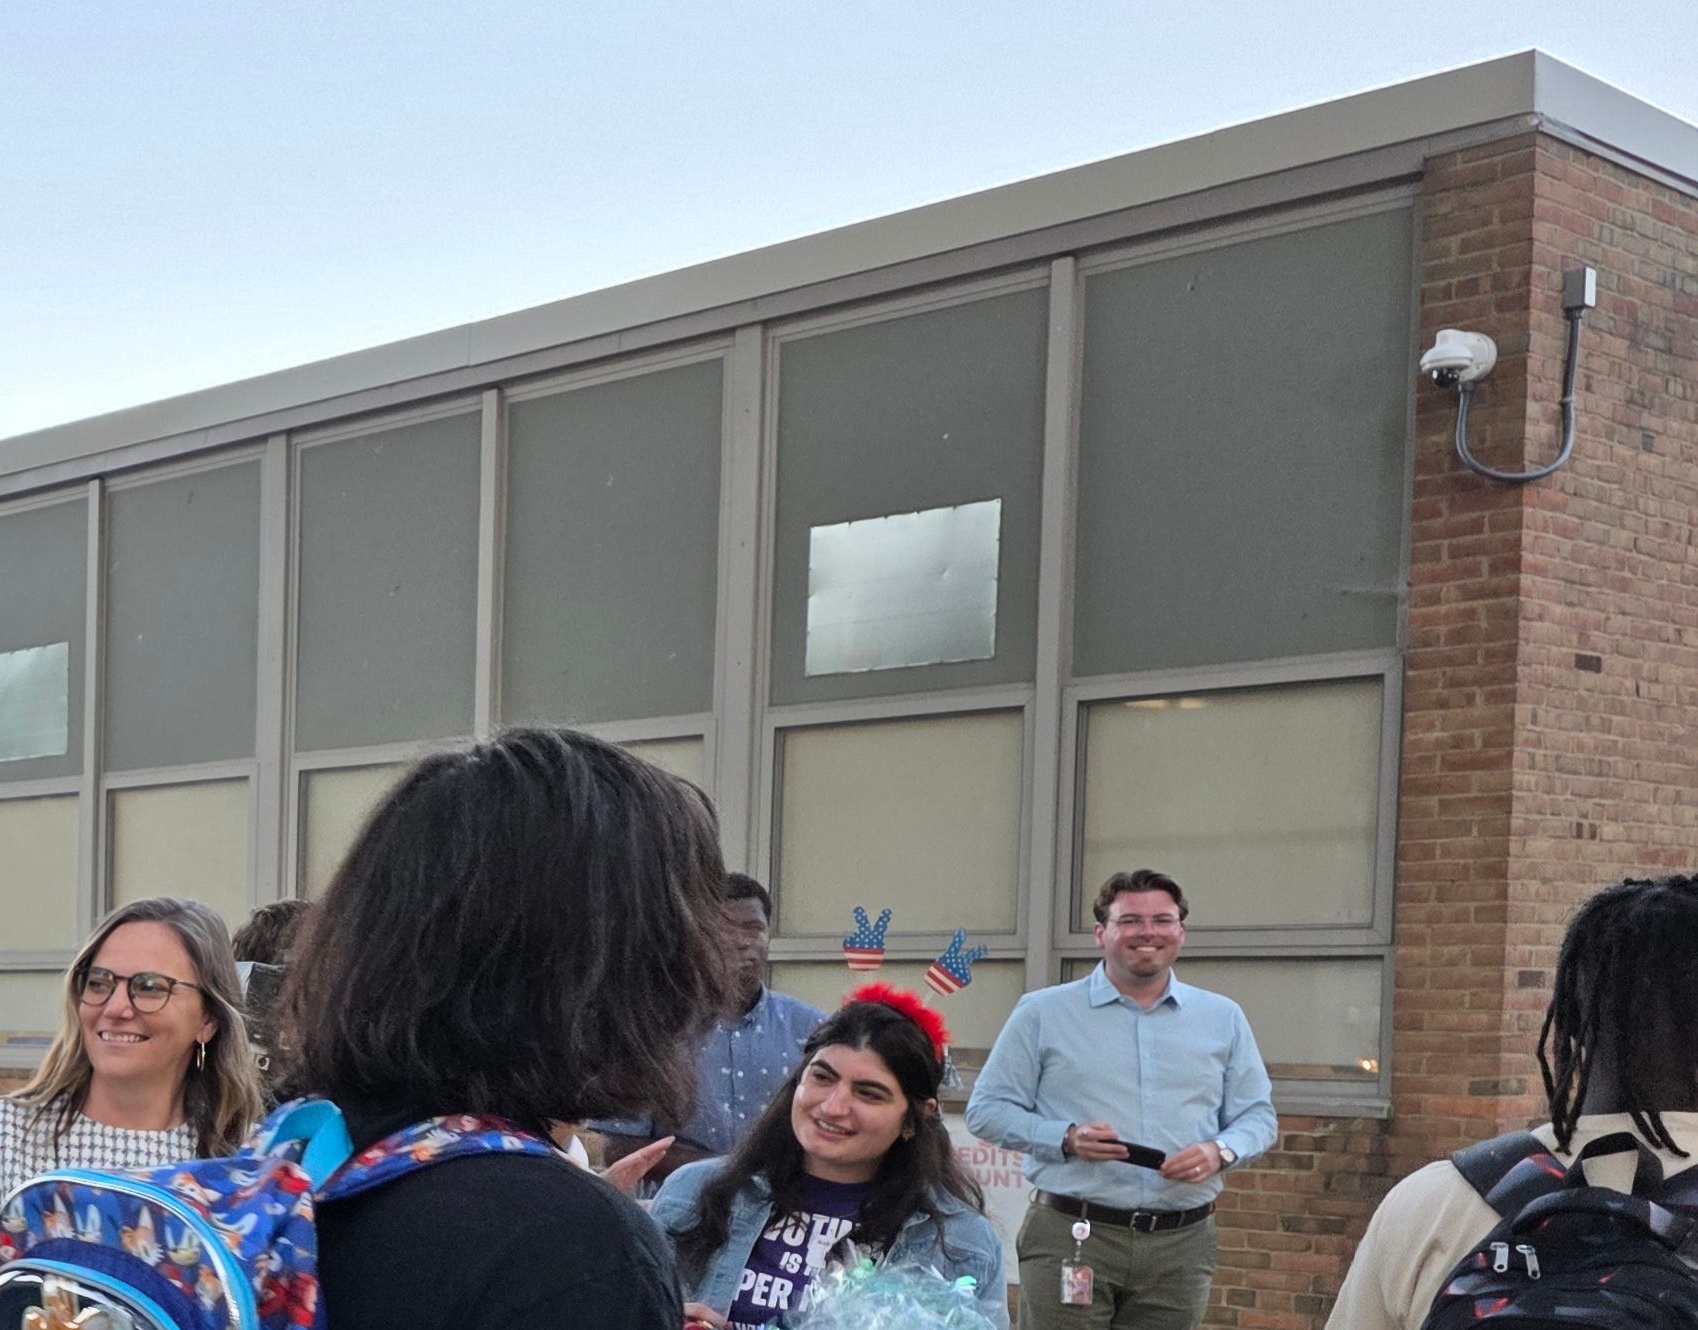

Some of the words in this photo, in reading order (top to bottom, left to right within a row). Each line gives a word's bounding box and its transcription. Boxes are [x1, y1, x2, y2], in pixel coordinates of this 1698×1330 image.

[957, 1146, 1022, 1168] EDITS
[974, 1168, 1025, 1188] UNT
[779, 1251, 803, 1274] IS
[734, 1267, 794, 1310] PER
